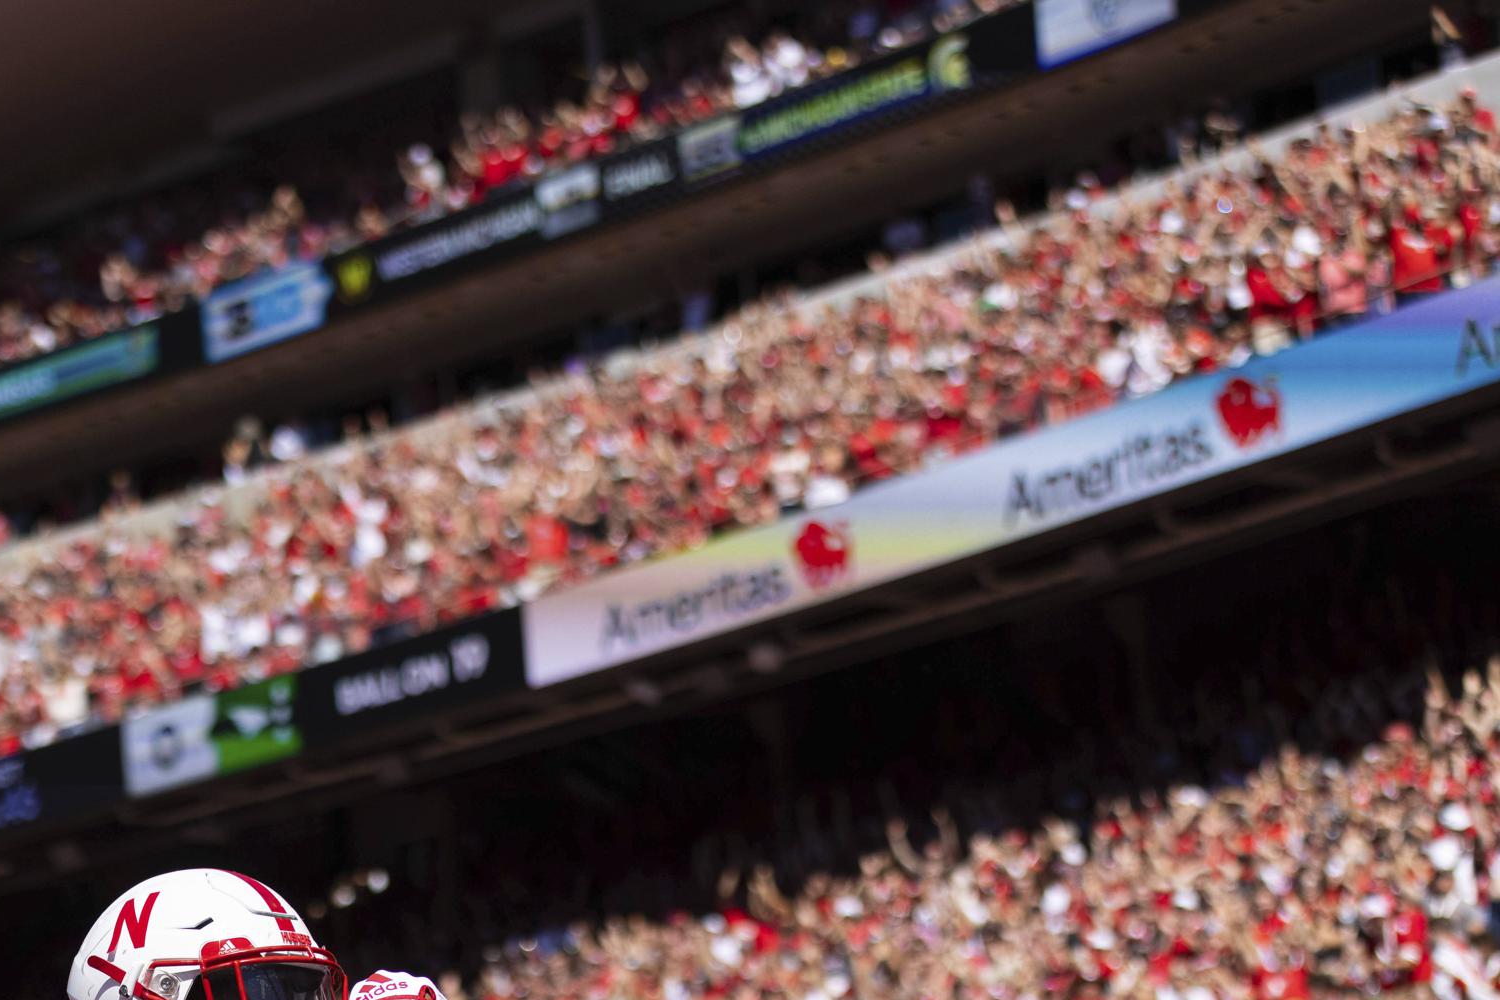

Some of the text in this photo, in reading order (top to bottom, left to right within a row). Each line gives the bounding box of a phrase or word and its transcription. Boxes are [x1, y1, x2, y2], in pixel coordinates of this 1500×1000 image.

[1005, 424, 1214, 526] Ameritas
[598, 563, 792, 653] Ameritas
[106, 891, 161, 954] N
